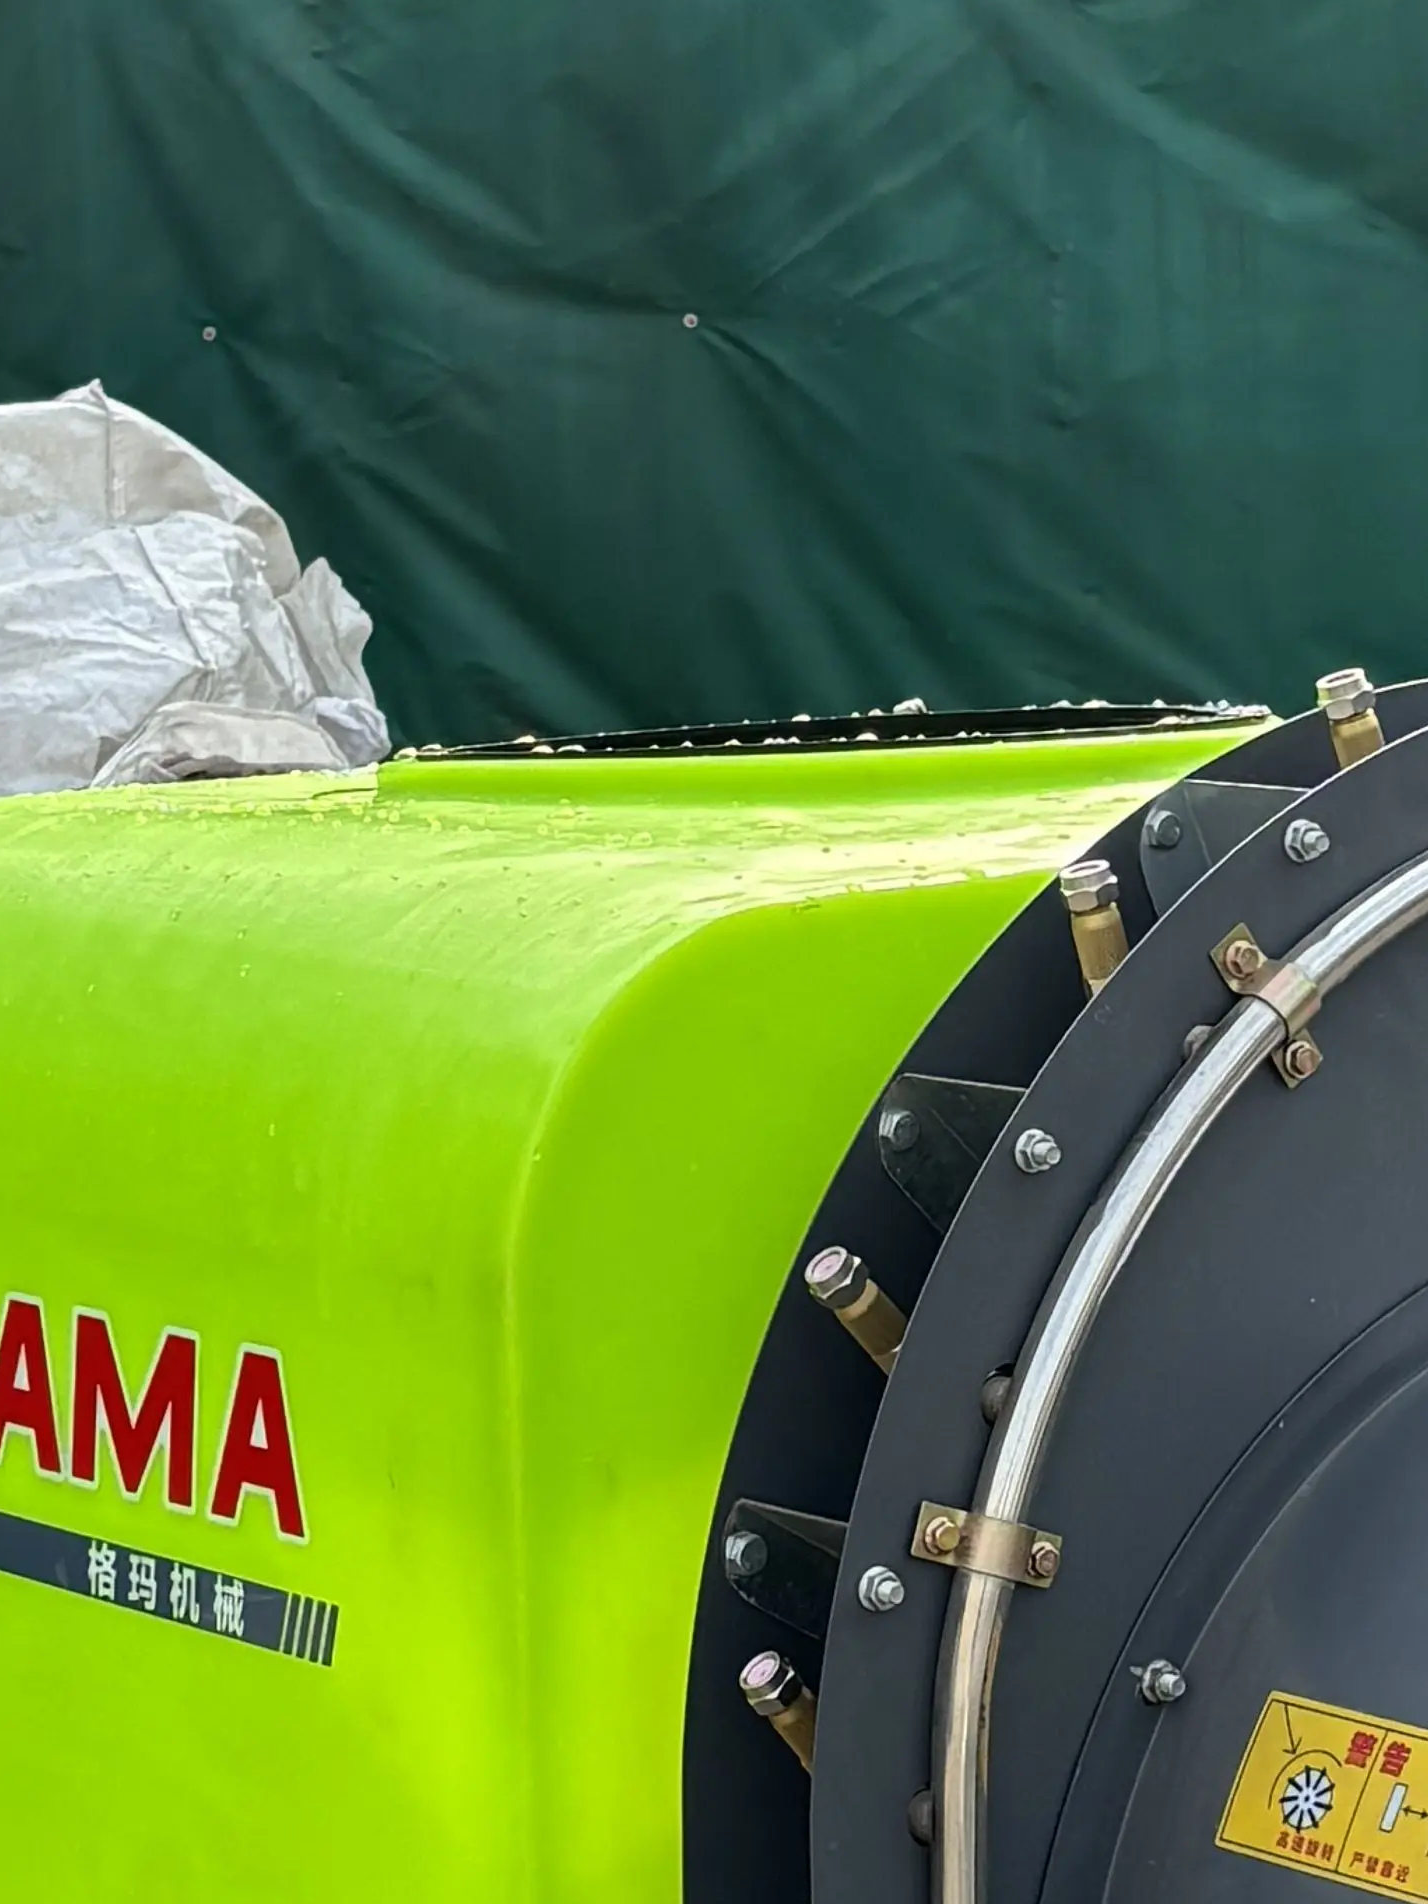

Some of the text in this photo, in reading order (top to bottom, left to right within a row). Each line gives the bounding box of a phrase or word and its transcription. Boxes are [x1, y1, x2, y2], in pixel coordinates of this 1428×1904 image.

[86, 1540, 246, 1638] 格玛机械
[1344, 1730, 1413, 1778] 警告
